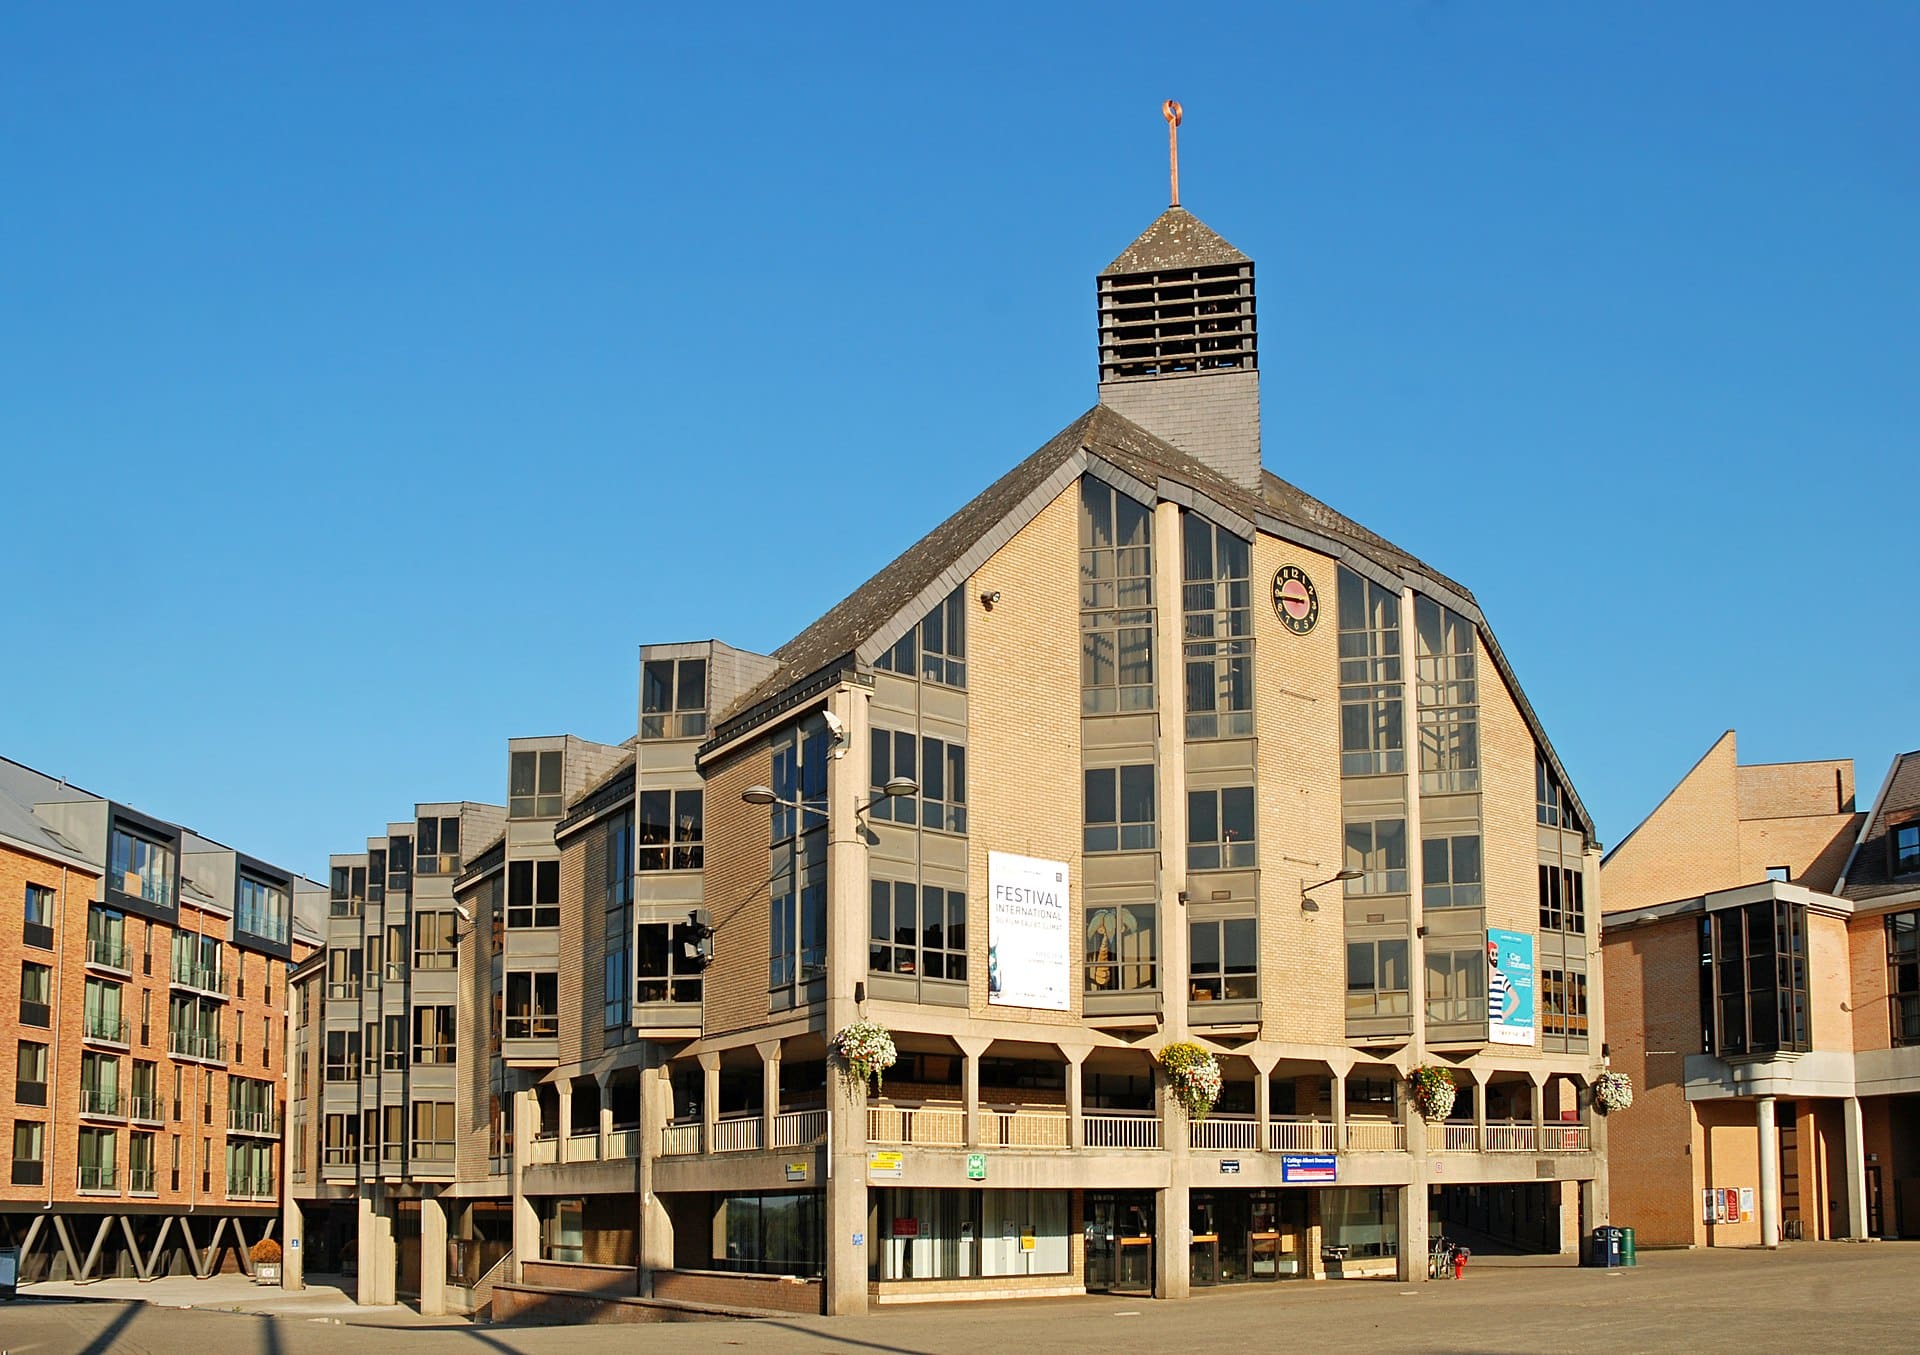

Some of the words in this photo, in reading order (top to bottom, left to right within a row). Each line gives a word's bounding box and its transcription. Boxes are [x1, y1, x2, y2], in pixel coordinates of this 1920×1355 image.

[1291, 568, 1299, 578] 12
[1308, 586, 1314, 595] 2
[1277, 603, 1283, 611] 8
[1312, 602, 1317, 610] 3
[1285, 615, 1290, 624] 7
[1309, 613, 1314, 622] 4
[1294, 621, 1299, 630] 6
[1303, 620, 1308, 629] 5
[996, 885, 1062, 908] FESTIVAL
[996, 904, 1062, 920] INTERNATIONAL
